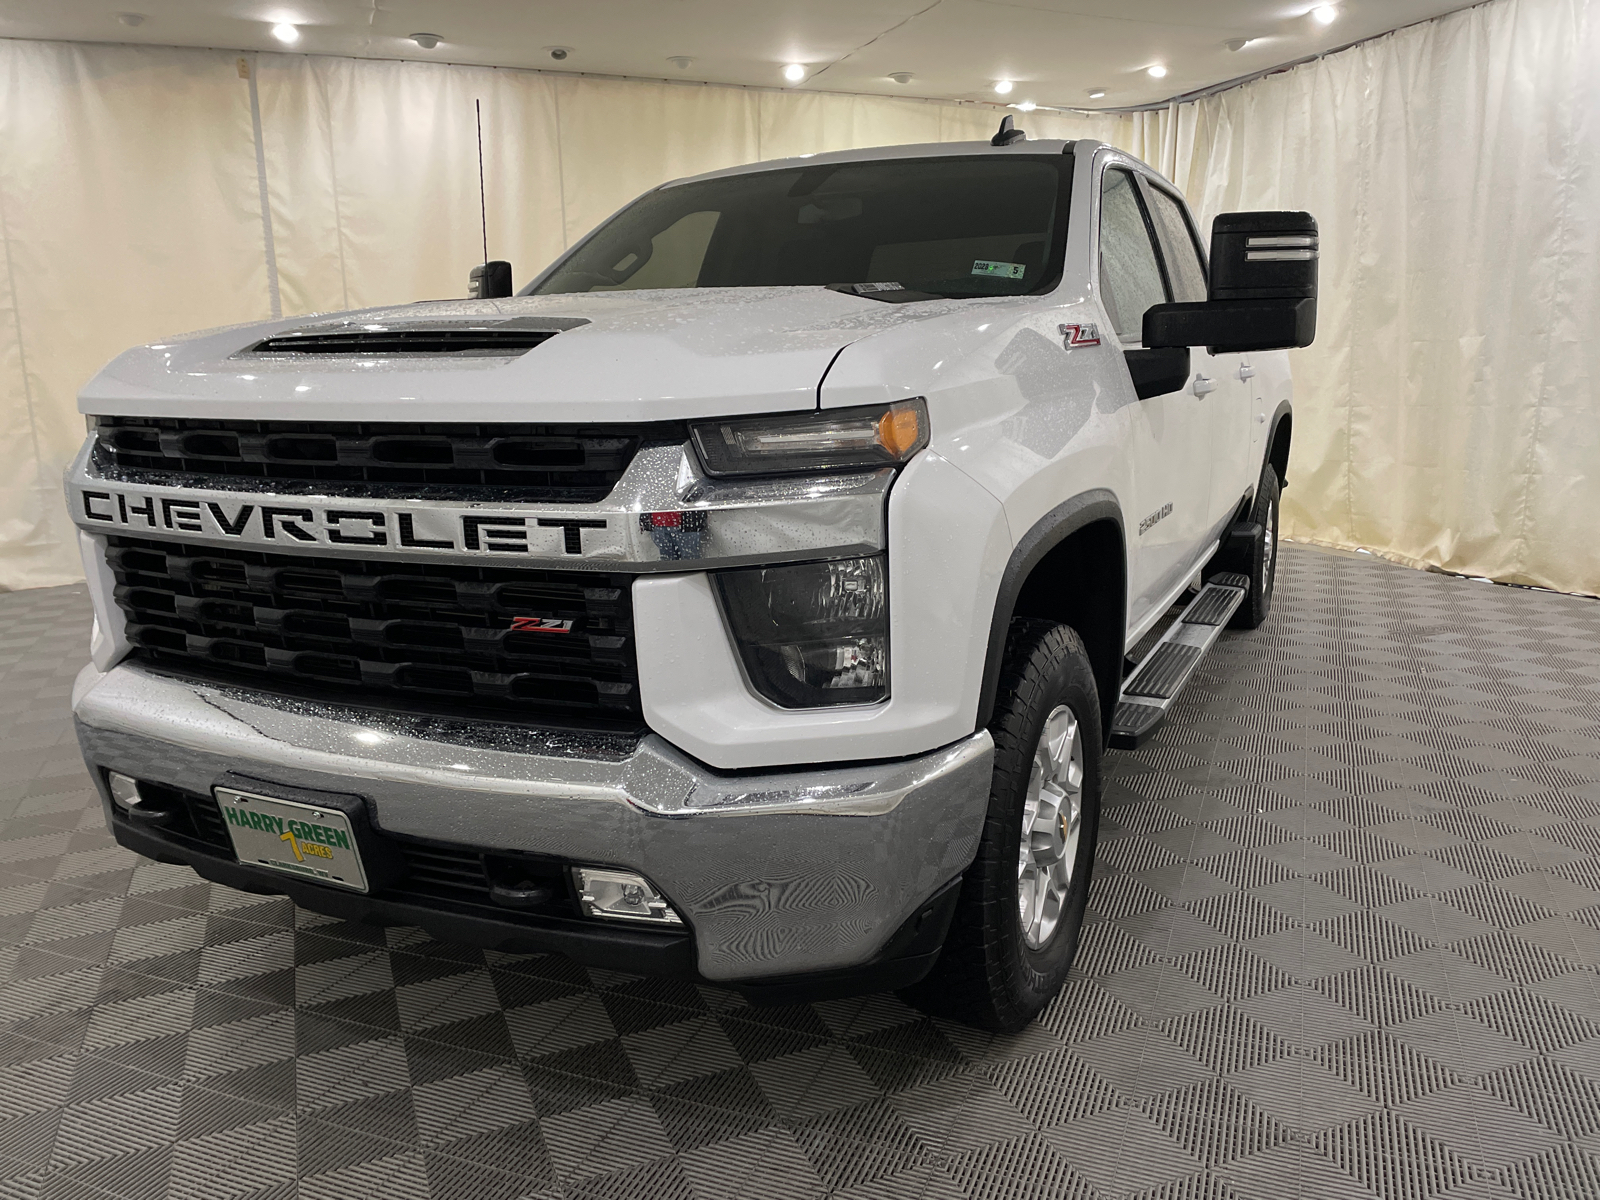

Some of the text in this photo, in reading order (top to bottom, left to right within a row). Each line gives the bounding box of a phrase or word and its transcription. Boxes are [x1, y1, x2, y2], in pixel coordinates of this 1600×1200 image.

[1013, 266, 1019, 274] 5
[1058, 323, 1101, 351] Z71
[82, 490, 608, 555] CHEVROLET
[510, 616, 574, 634] Z71
[224, 806, 350, 850] HARRY GREEN
[280, 831, 304, 862] 7
[301, 842, 334, 860] ACRES
